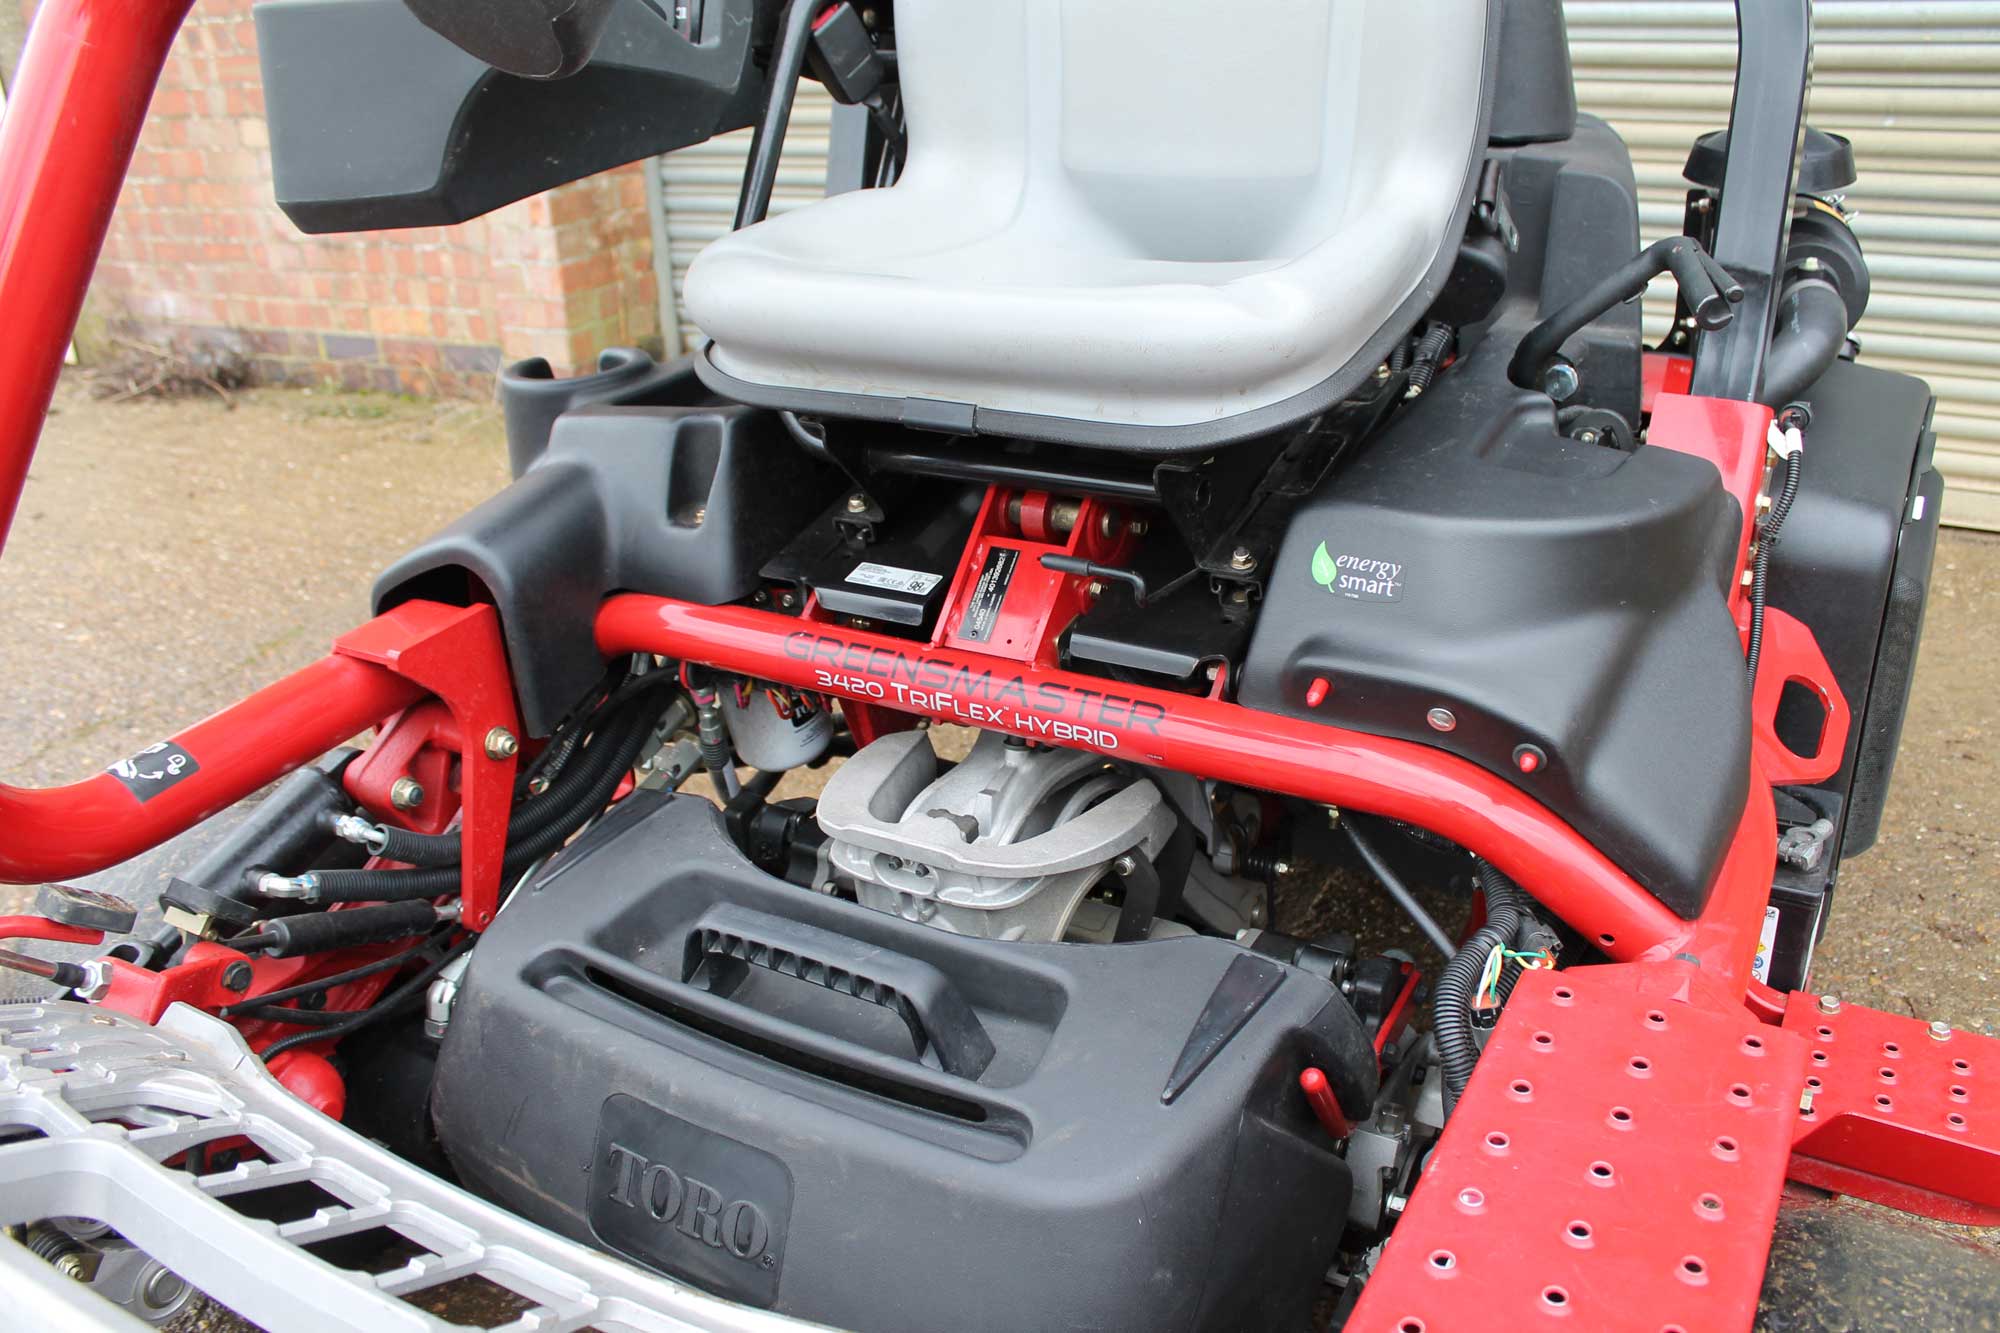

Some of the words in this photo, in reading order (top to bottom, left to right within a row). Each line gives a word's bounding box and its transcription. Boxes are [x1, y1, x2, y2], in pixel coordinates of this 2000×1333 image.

[1335, 554, 1402, 580] energy
[1338, 574, 1395, 597] smart
[783, 630, 1166, 736] GREENSMASTER
[814, 669, 885, 699] 3420
[1014, 712, 1120, 750] HYBRID
[608, 1141, 768, 1260] TORO
